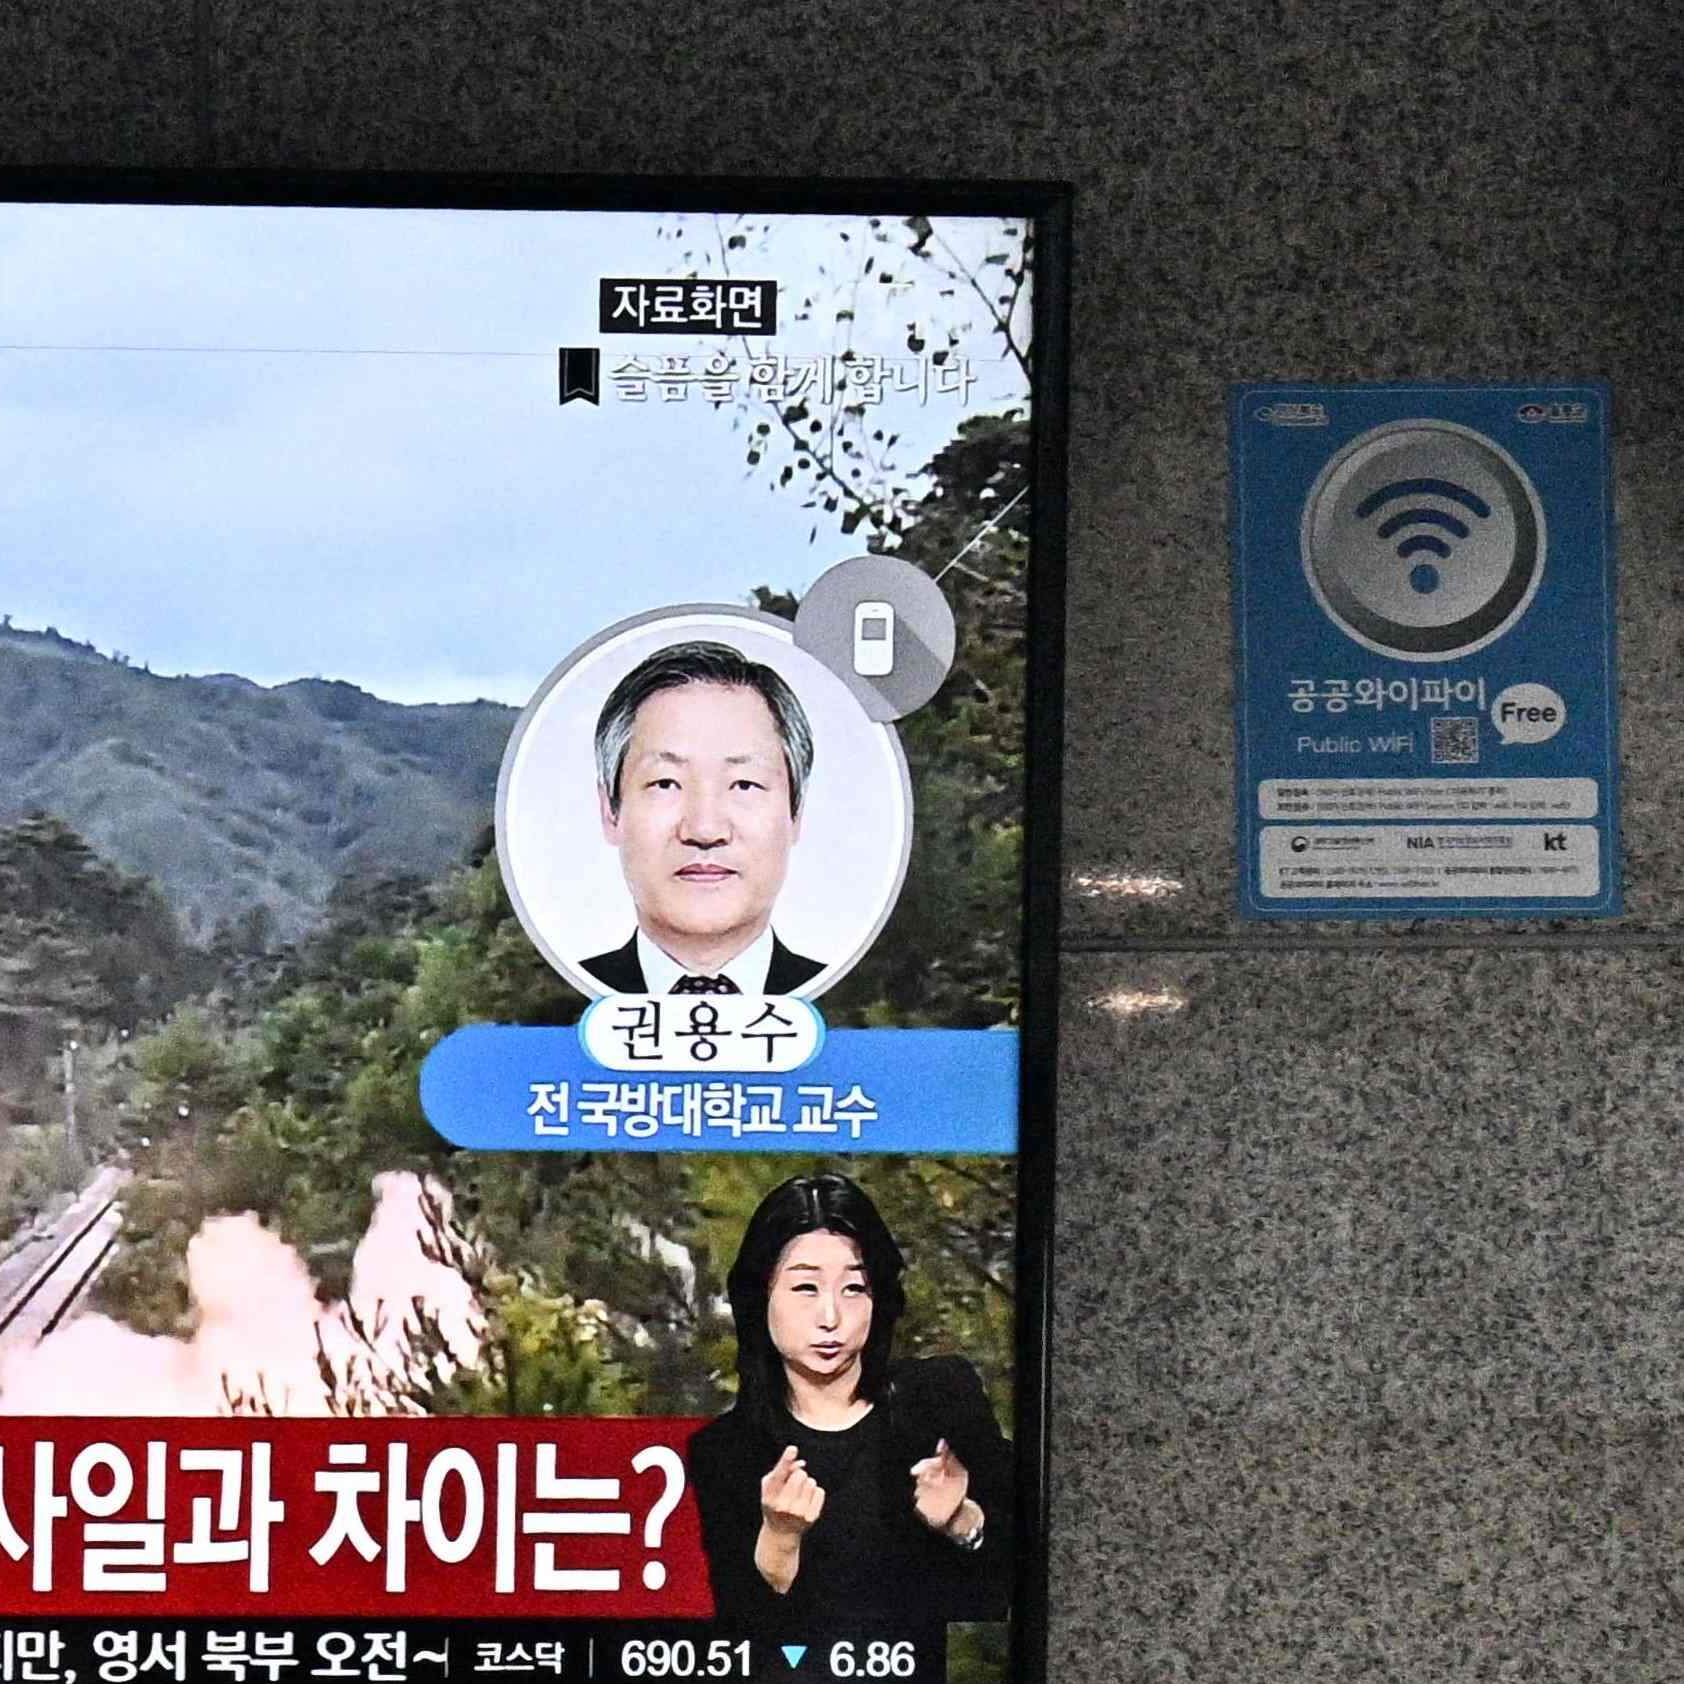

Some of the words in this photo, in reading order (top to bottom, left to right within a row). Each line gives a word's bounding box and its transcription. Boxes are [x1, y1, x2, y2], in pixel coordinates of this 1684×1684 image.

[611, 284, 764, 331] 자료화면
[608, 353, 740, 402] 슬픔을
[749, 353, 836, 405] 함께
[844, 355, 978, 407] 합니다
[1286, 677, 1487, 713] 공공와이파이
[1500, 702, 1558, 723] Free
[1297, 735, 1362, 754] Public
[1367, 730, 1416, 753] WiFi
[1406, 836, 1434, 850] NIA
[1543, 832, 1569, 852] kt
[612, 1001, 800, 1063] 권용수
[526, 1081, 570, 1137] 전
[576, 1081, 787, 1139] 국방대학교
[792, 1084, 880, 1139] 교수
[307, 1443, 688, 1595] 차이는?
[92, 1629, 187, 1683] 영서
[199, 1630, 300, 1684] 북부
[473, 1640, 566, 1675] 코스닥
[619, 1640, 752, 1679] 690.51
[829, 1640, 916, 1679] 6.86
